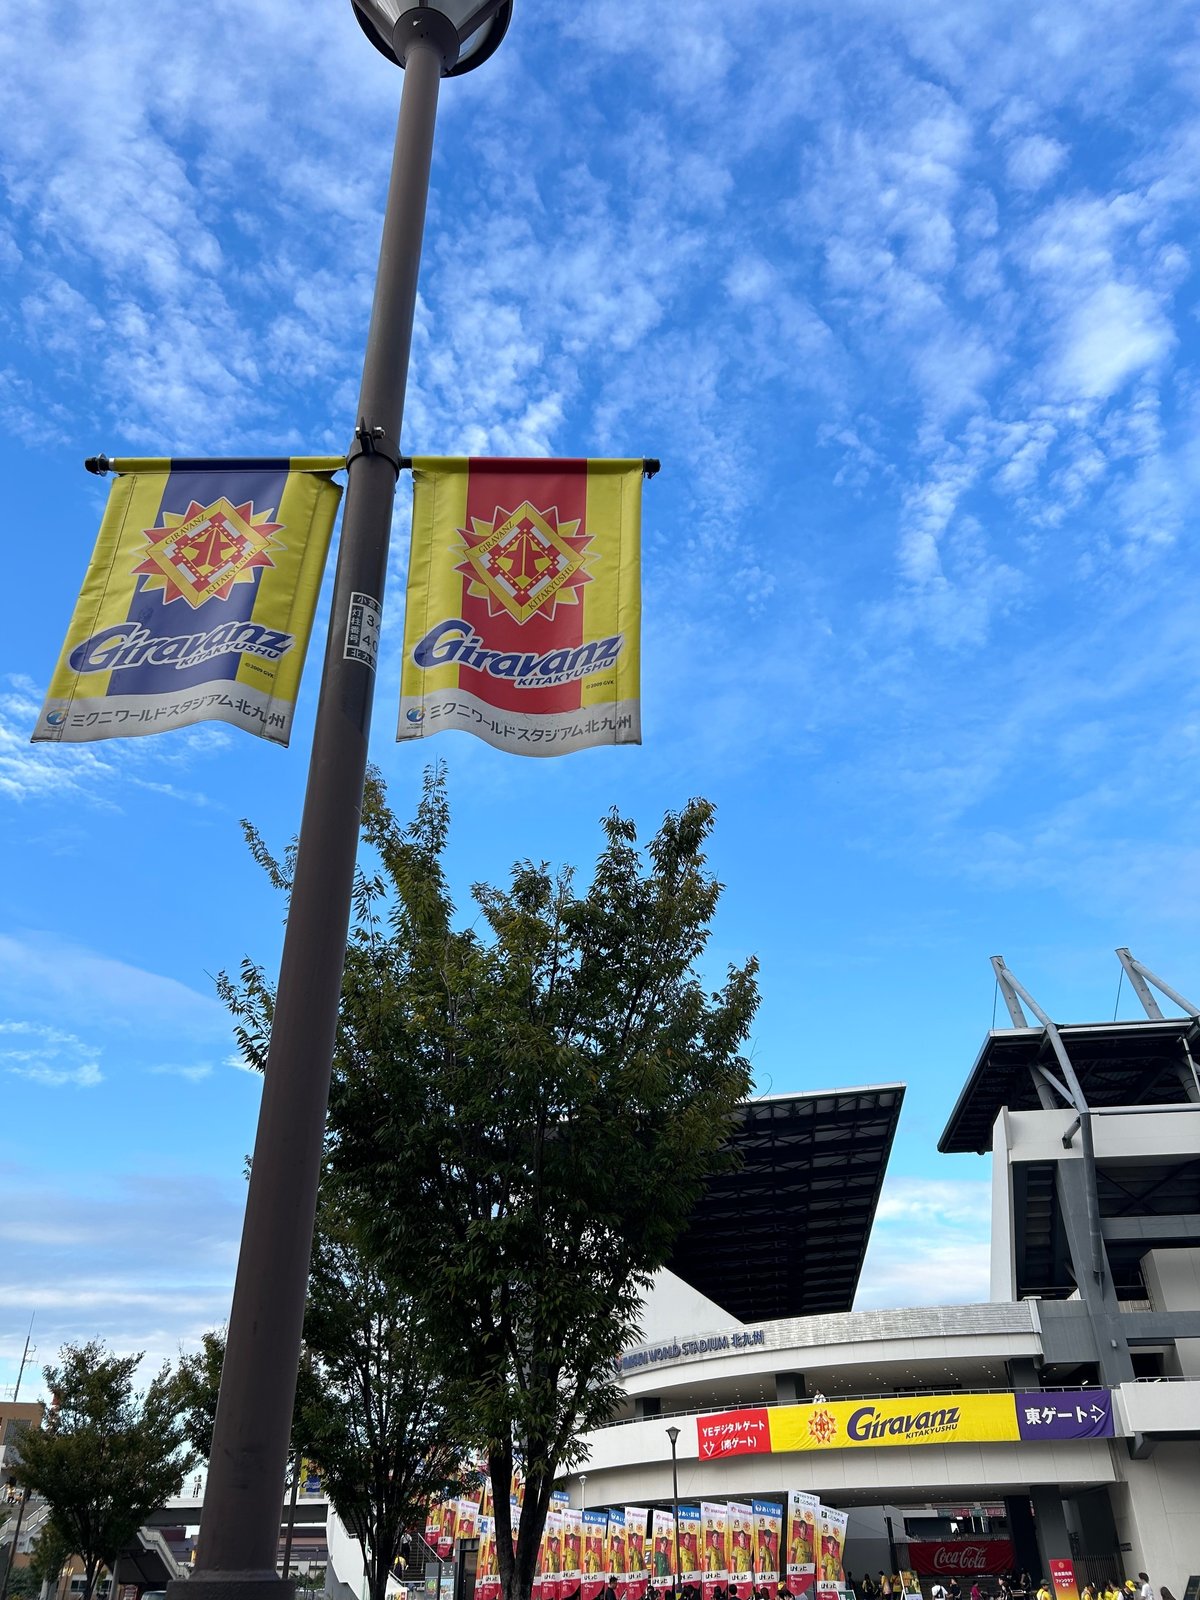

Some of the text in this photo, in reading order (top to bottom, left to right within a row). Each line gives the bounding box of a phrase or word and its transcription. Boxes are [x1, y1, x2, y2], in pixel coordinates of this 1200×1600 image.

[165, 514, 207, 545] GIRAVANZ
[478, 521, 514, 553] GIRAVANZ
[528, 564, 575, 610] KITAKYUSHU
[349, 608, 361, 643] 灯柱番号
[69, 623, 293, 673] Giravanz
[179, 641, 281, 668] KITAKYUSHU
[413, 619, 623, 677] Giravanz
[517, 658, 615, 686] KITAKYUSHU
[70, 694, 286, 729] ミクニワールドスタジアム北九州
[430, 702, 632, 743] ミクニワールドスタジアム北九州
[650, 1344, 681, 1362] WORLD
[682, 1336, 729, 1355] STADIUM
[731, 1330, 764, 1348] 北九州
[703, 1420, 765, 1437] YEデジタルゲート
[847, 1407, 960, 1441] Giravanz
[1025, 1405, 1087, 1425] 東ゲート
[905, 1424, 958, 1439] KITAKYUSHU
[934, 1546, 988, 1570] Coca-Cola
